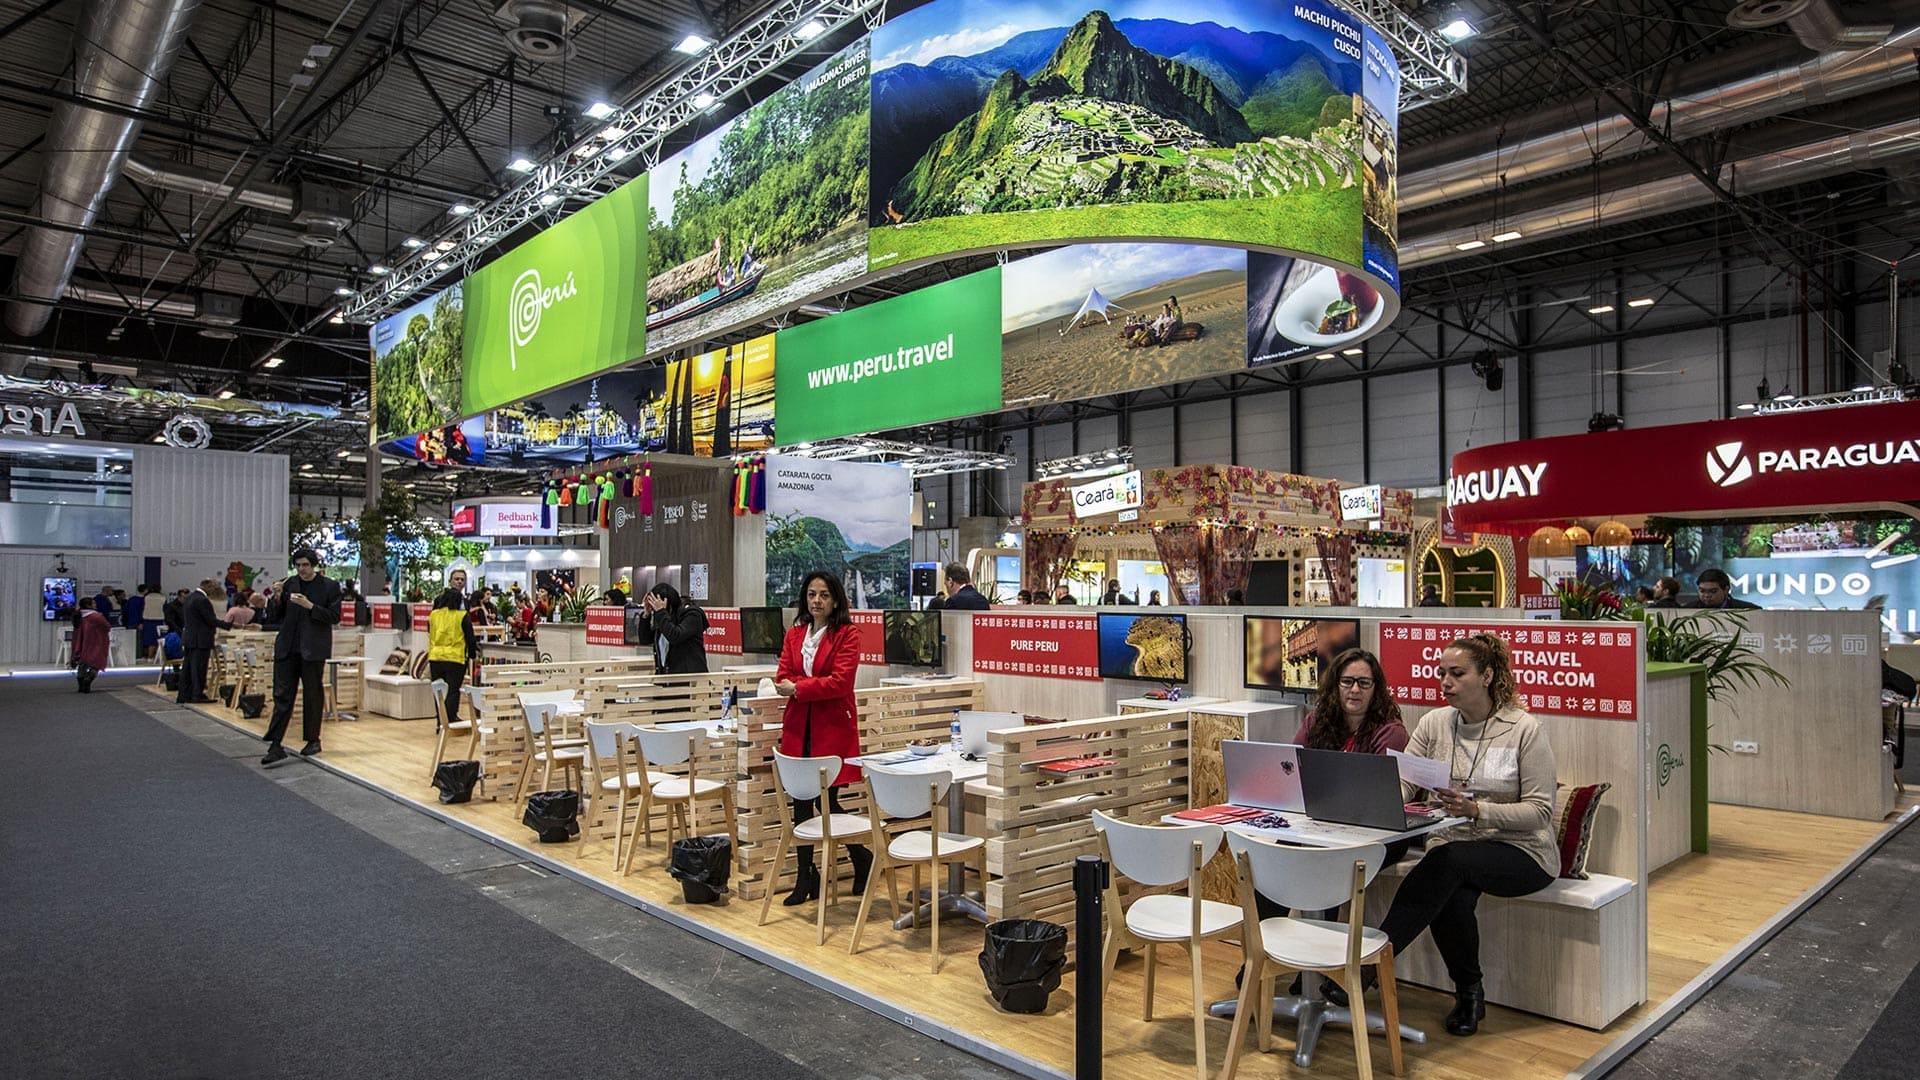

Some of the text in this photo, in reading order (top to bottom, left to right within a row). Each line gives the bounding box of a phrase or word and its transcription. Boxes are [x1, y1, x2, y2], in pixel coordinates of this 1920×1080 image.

[1294, 5, 1361, 43] MACHU PICCHU
[1333, 38, 1361, 60] CUSCO
[804, 49, 866, 95] AMAZONAS RIVER
[837, 65, 866, 89] LORETO
[510, 268, 577, 372] Perú
[807, 333, 954, 389] www.peru.travel
[1758, 439, 1920, 474] PARAGUA
[777, 470, 832, 481] CATARATA GOCTA
[777, 482, 815, 491] AMAZONAS
[1447, 462, 1548, 509] RAGUAY
[1076, 483, 1114, 506] Ceará
[1342, 490, 1366, 510] Ceará
[498, 512, 539, 521] Bedbank
[1728, 572, 1871, 595] MUNDO
[1010, 639, 1059, 653] PURE PERU
[1422, 646, 1581, 668] CA TRAVEL
[1512, 668, 1595, 688] TOR.COM
